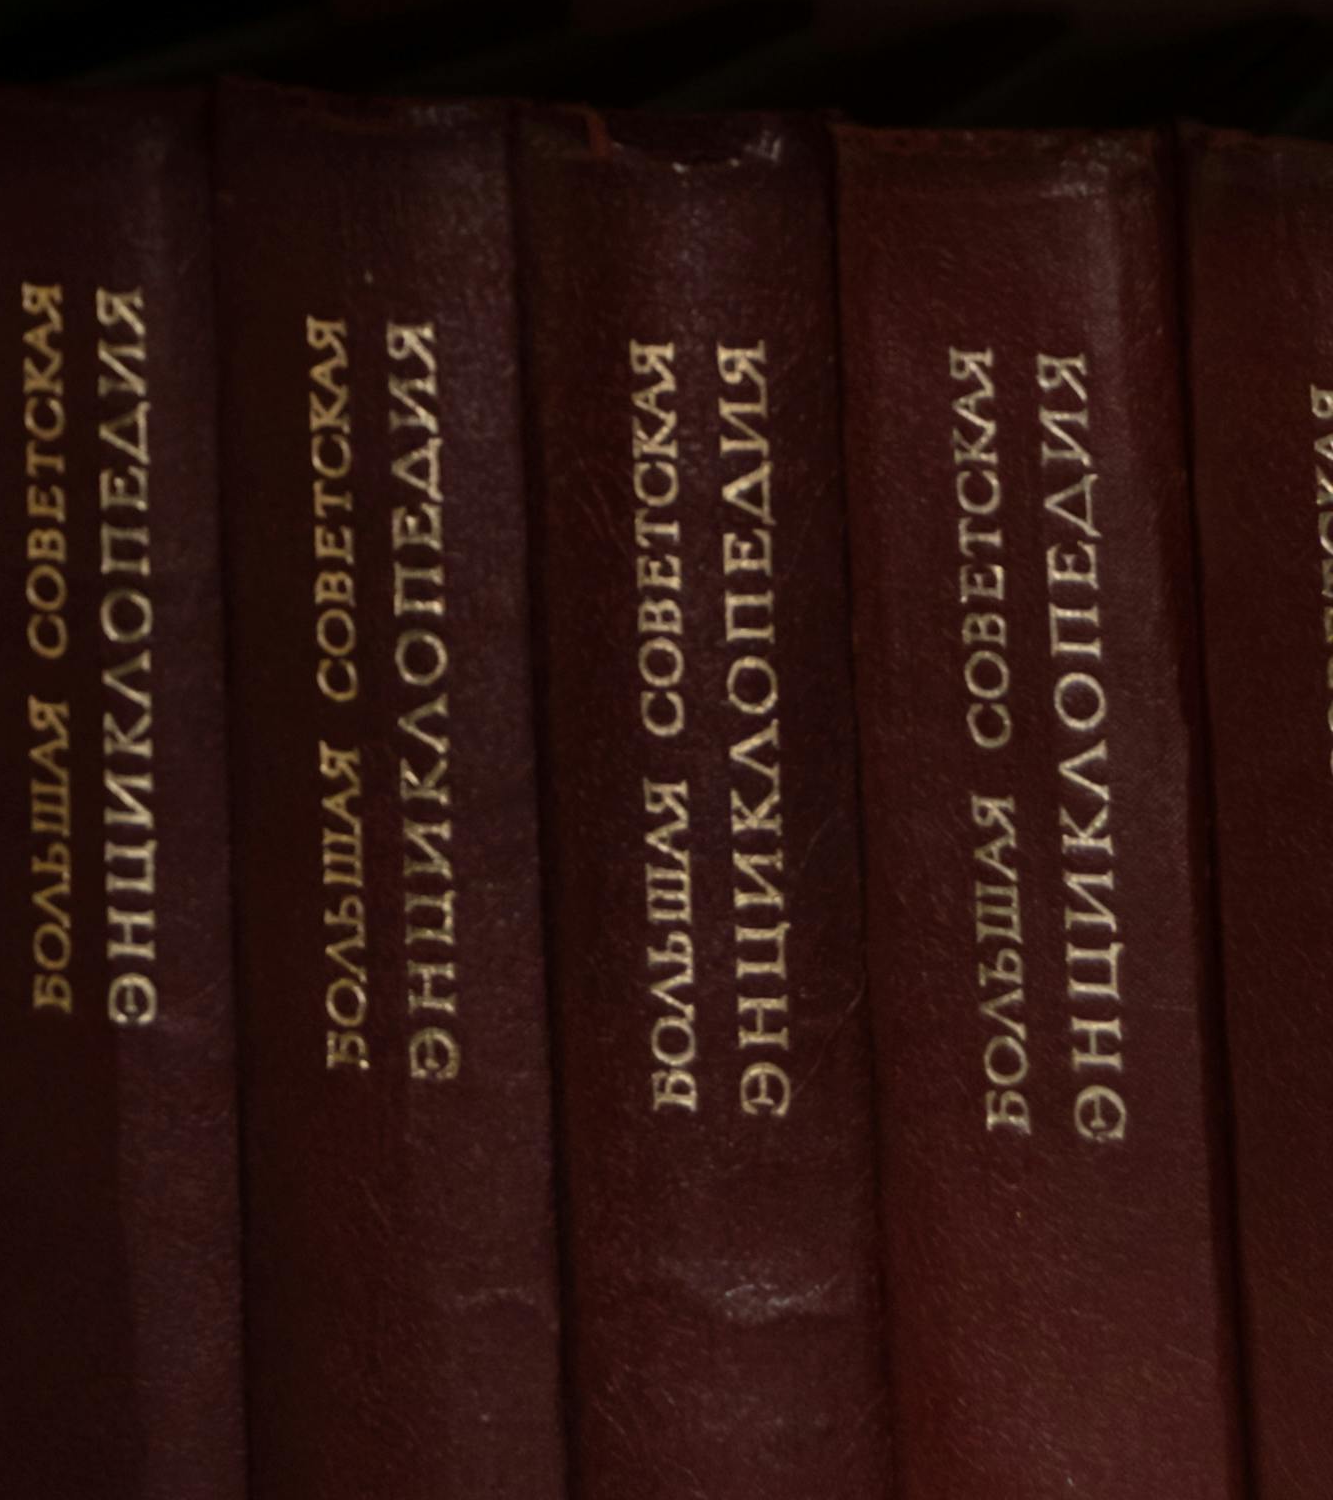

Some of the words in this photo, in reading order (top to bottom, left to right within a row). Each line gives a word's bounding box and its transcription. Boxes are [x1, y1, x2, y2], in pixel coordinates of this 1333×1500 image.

[20, 281, 71, 662] СОВЕТСКАЯ
[95, 286, 161, 1028] ЭНЦИКЛОПЕДИЯ
[305, 314, 360, 704] СОВЕТСКАЯ
[629, 340, 687, 740] СОВЕТСКАЯ
[948, 345, 1014, 750] СОВЕТСКАЯ
[28, 695, 74, 1016] БОЛЬШАЯ
[386, 318, 462, 1083] ЭНЦИКЛОПЕДИЯ
[716, 340, 792, 1120] ЭНЦИКЛОПЕДИЯ
[1036, 352, 1129, 1145] ЭНЦИКЛОПЕДИЯ
[319, 740, 371, 1073] БОЛЬШАЯ
[642, 777, 699, 1115] БОЛЬШАЯ
[969, 793, 1034, 1138] БОЛЬШАЯ
